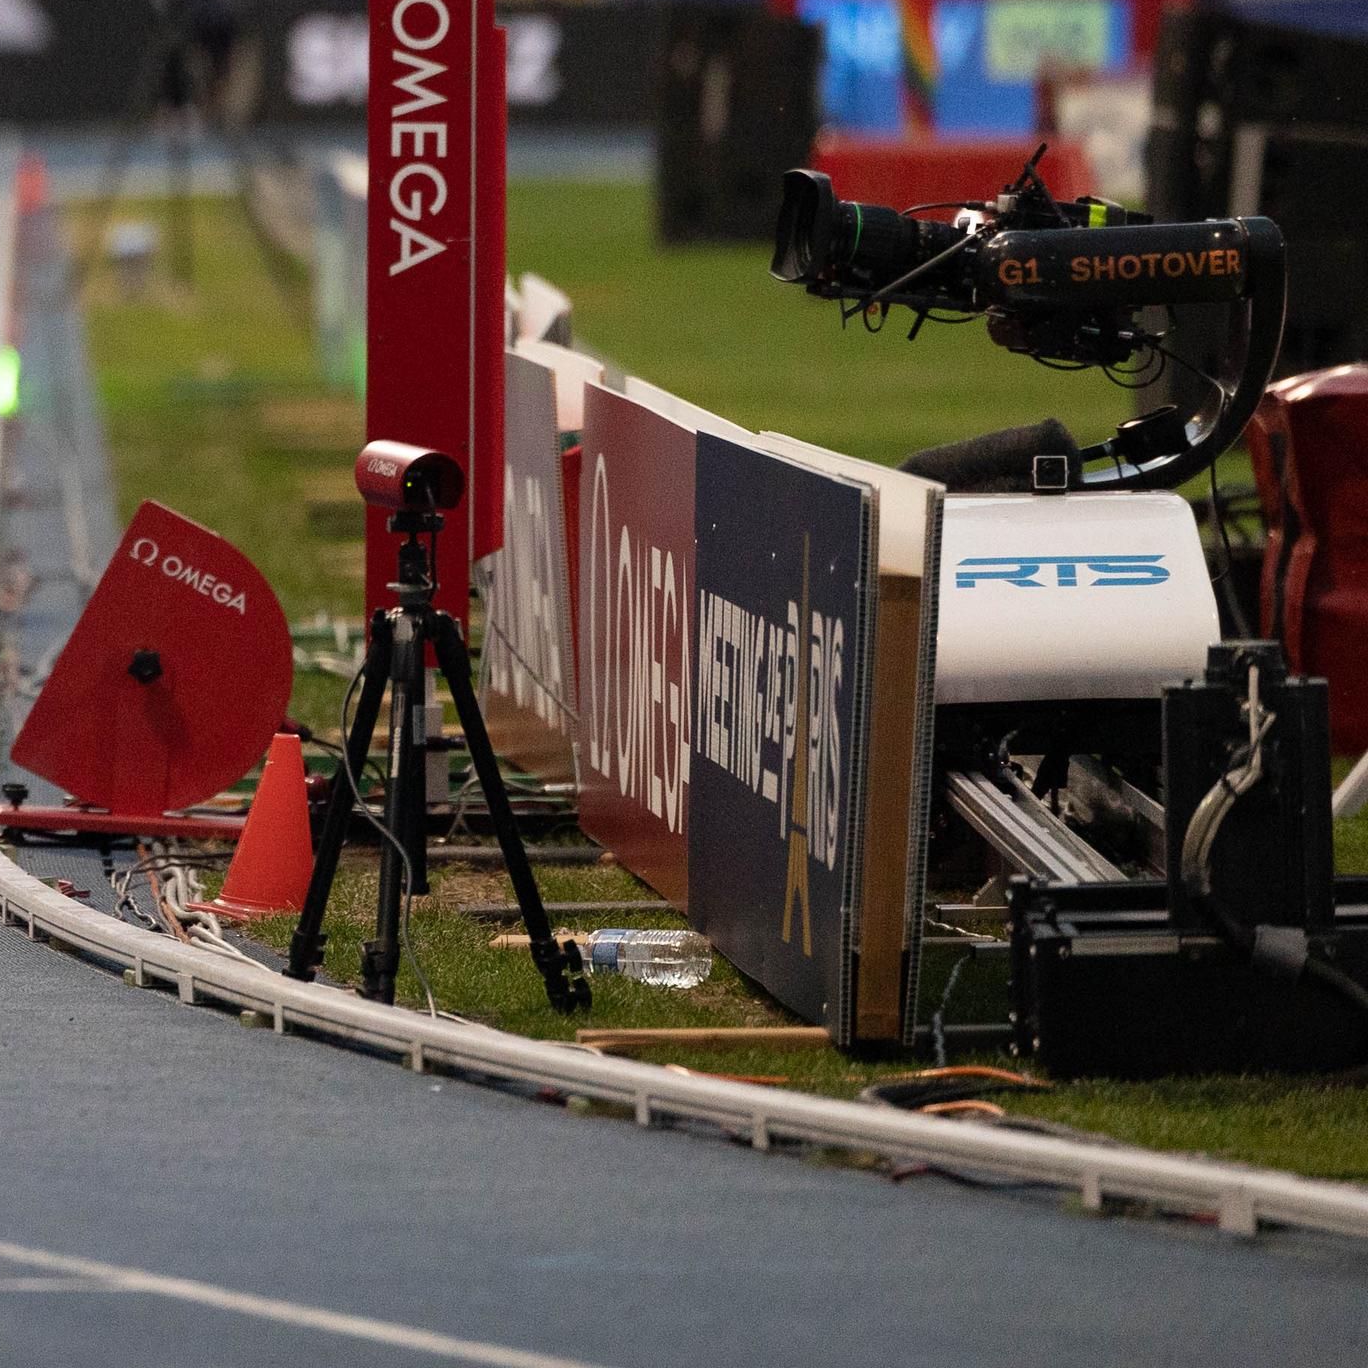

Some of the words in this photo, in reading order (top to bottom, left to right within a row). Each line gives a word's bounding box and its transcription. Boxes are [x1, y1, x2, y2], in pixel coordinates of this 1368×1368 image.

[998, 258, 1042, 286] G1
[1071, 249, 1241, 282] SHOTOVER
[162, 556, 245, 615] OMEGA
[955, 554, 1170, 589] RTS
[616, 524, 691, 835] OMEGA
[696, 589, 764, 794] MEETING
[764, 623, 784, 772] DE
